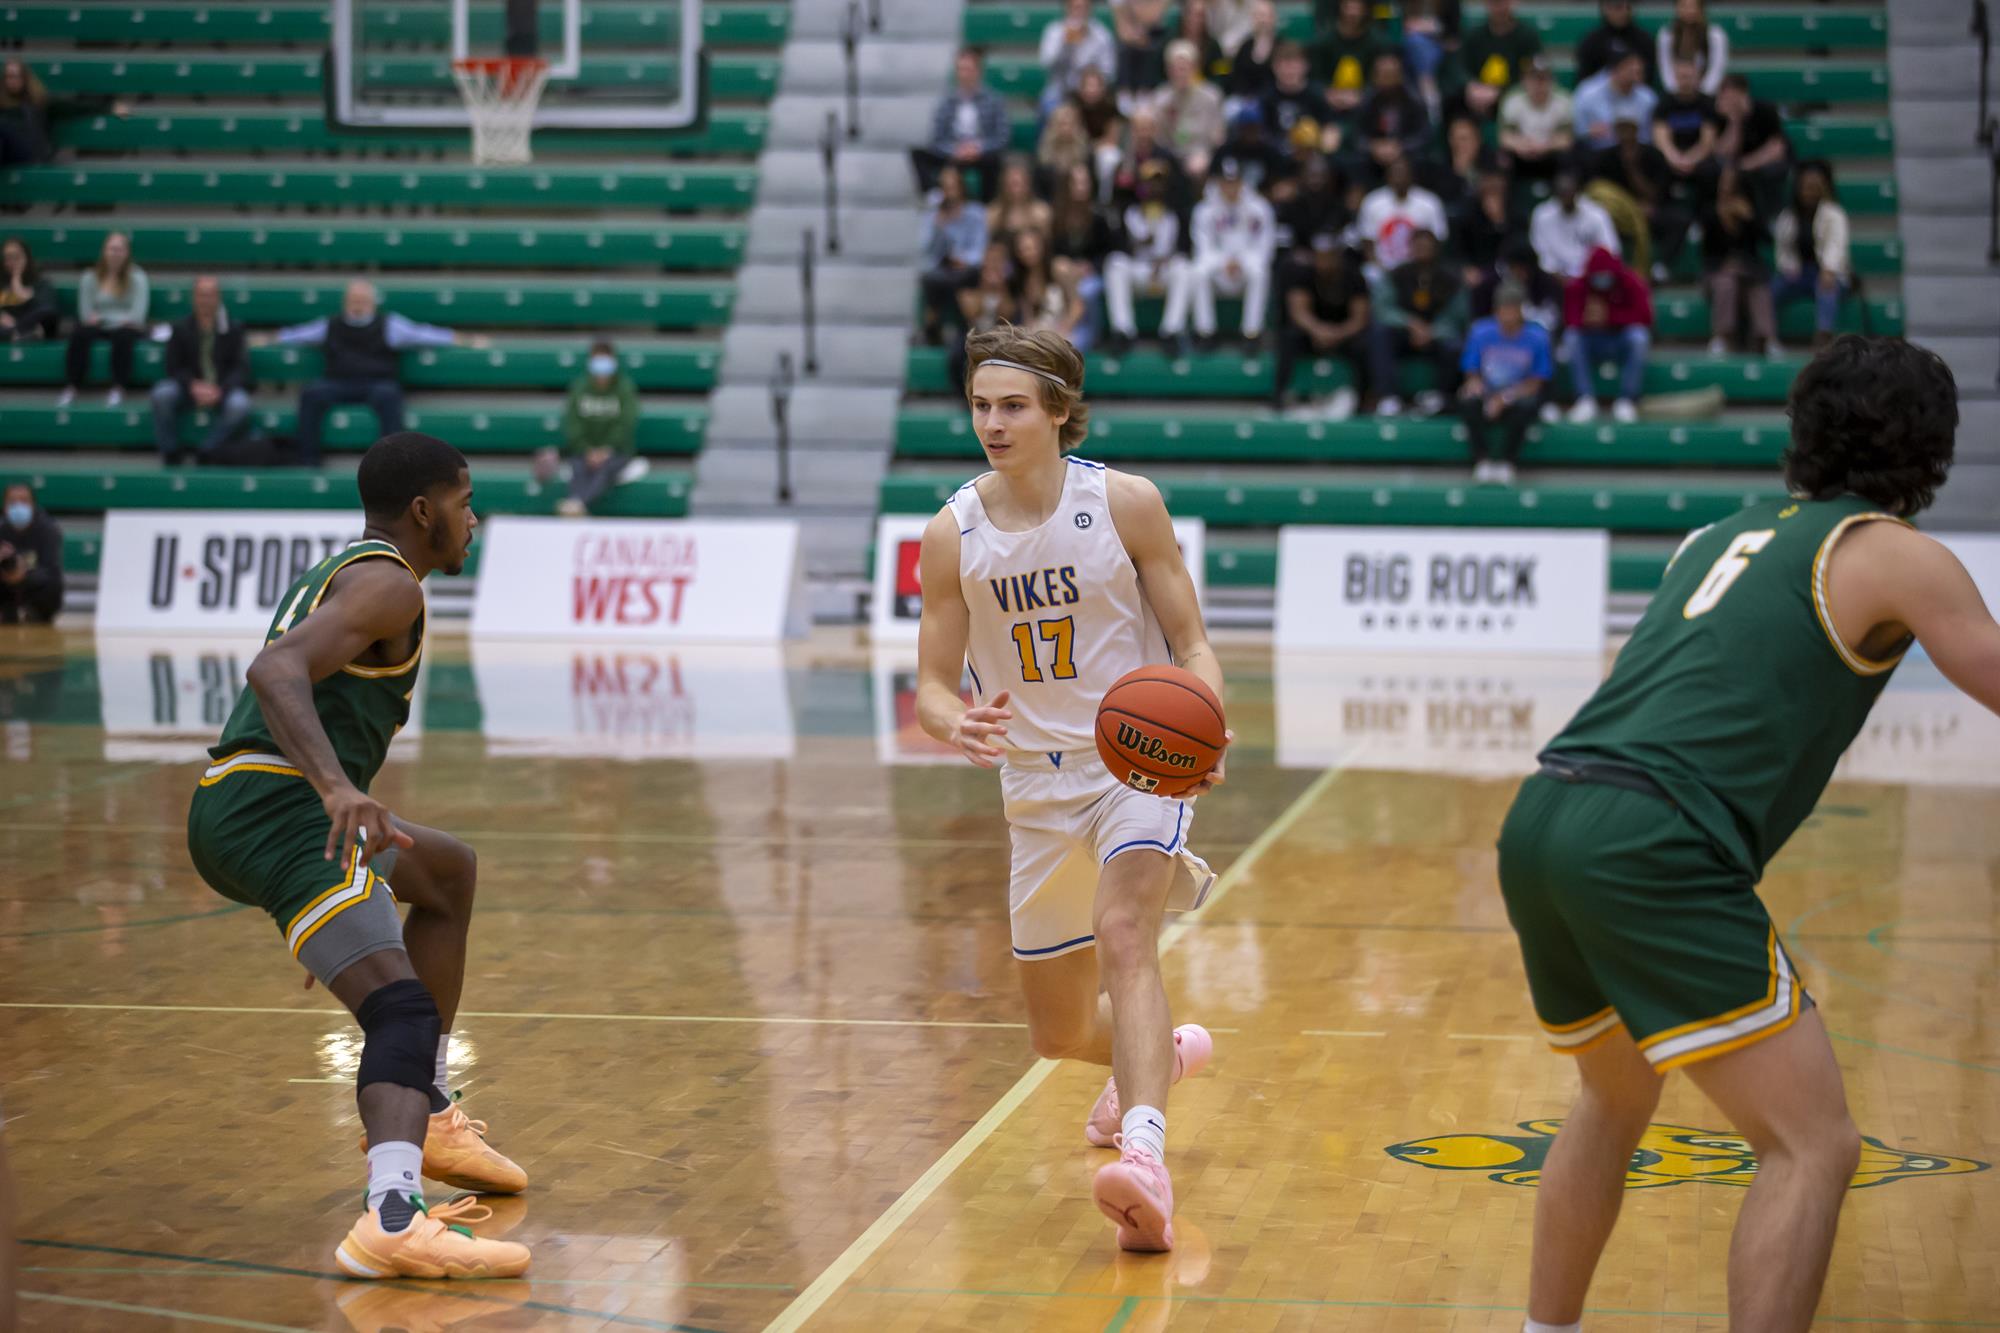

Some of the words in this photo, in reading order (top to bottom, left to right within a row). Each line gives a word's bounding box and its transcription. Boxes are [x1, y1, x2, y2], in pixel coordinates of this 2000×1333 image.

[1076, 514, 1091, 527] 13
[199, 535, 363, 610] SPOR
[575, 534, 697, 568] CANADA
[1682, 528, 1777, 620] 6
[573, 575, 692, 626] WEST
[989, 565, 1080, 613] VIKES
[1428, 553, 1538, 607] ROCK
[1011, 614, 1078, 683] 17
[1117, 720, 1197, 769] Wilson
